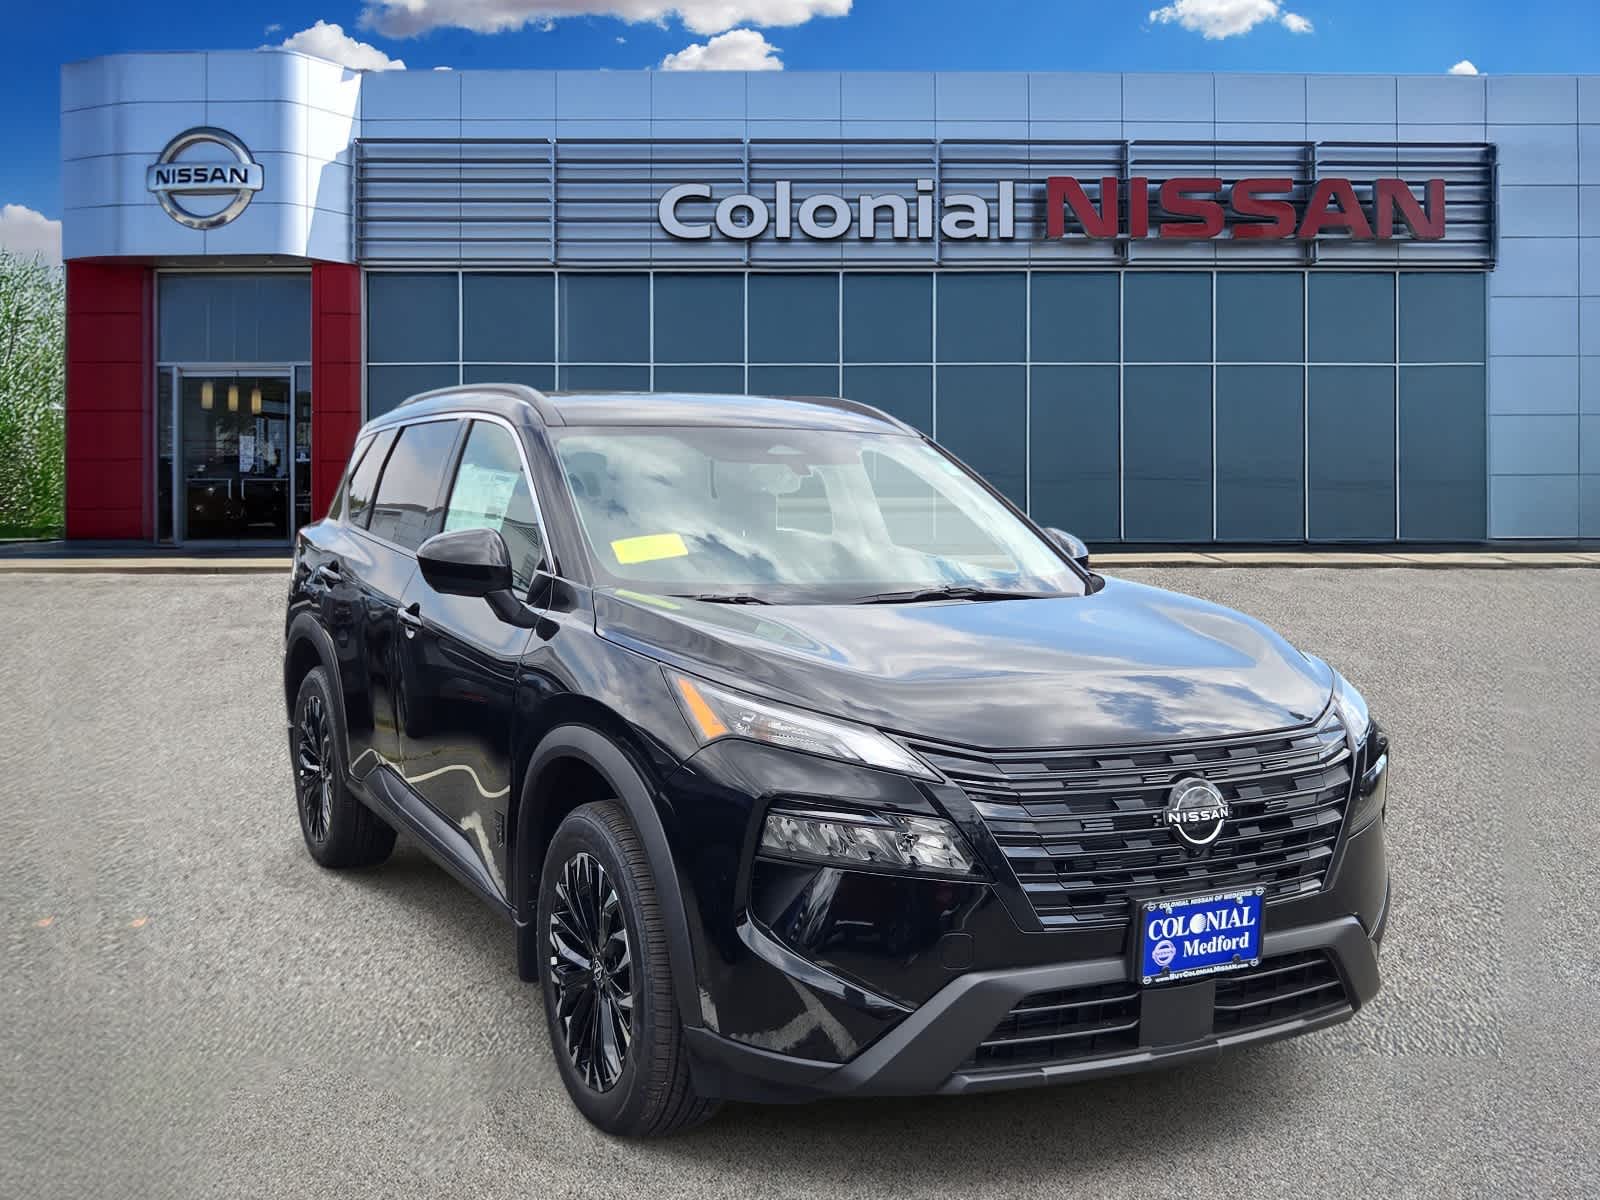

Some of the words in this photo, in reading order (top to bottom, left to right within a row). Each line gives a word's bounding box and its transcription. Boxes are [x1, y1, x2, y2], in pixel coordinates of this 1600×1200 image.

[155, 167, 249, 185] NISSAN
[658, 179, 1015, 240] Colonial
[1045, 176, 1447, 240] NISSAN
[1168, 806, 1229, 824] NISSAN
[1149, 906, 1255, 941] COLONIAL
[1183, 931, 1249, 958] Medford
